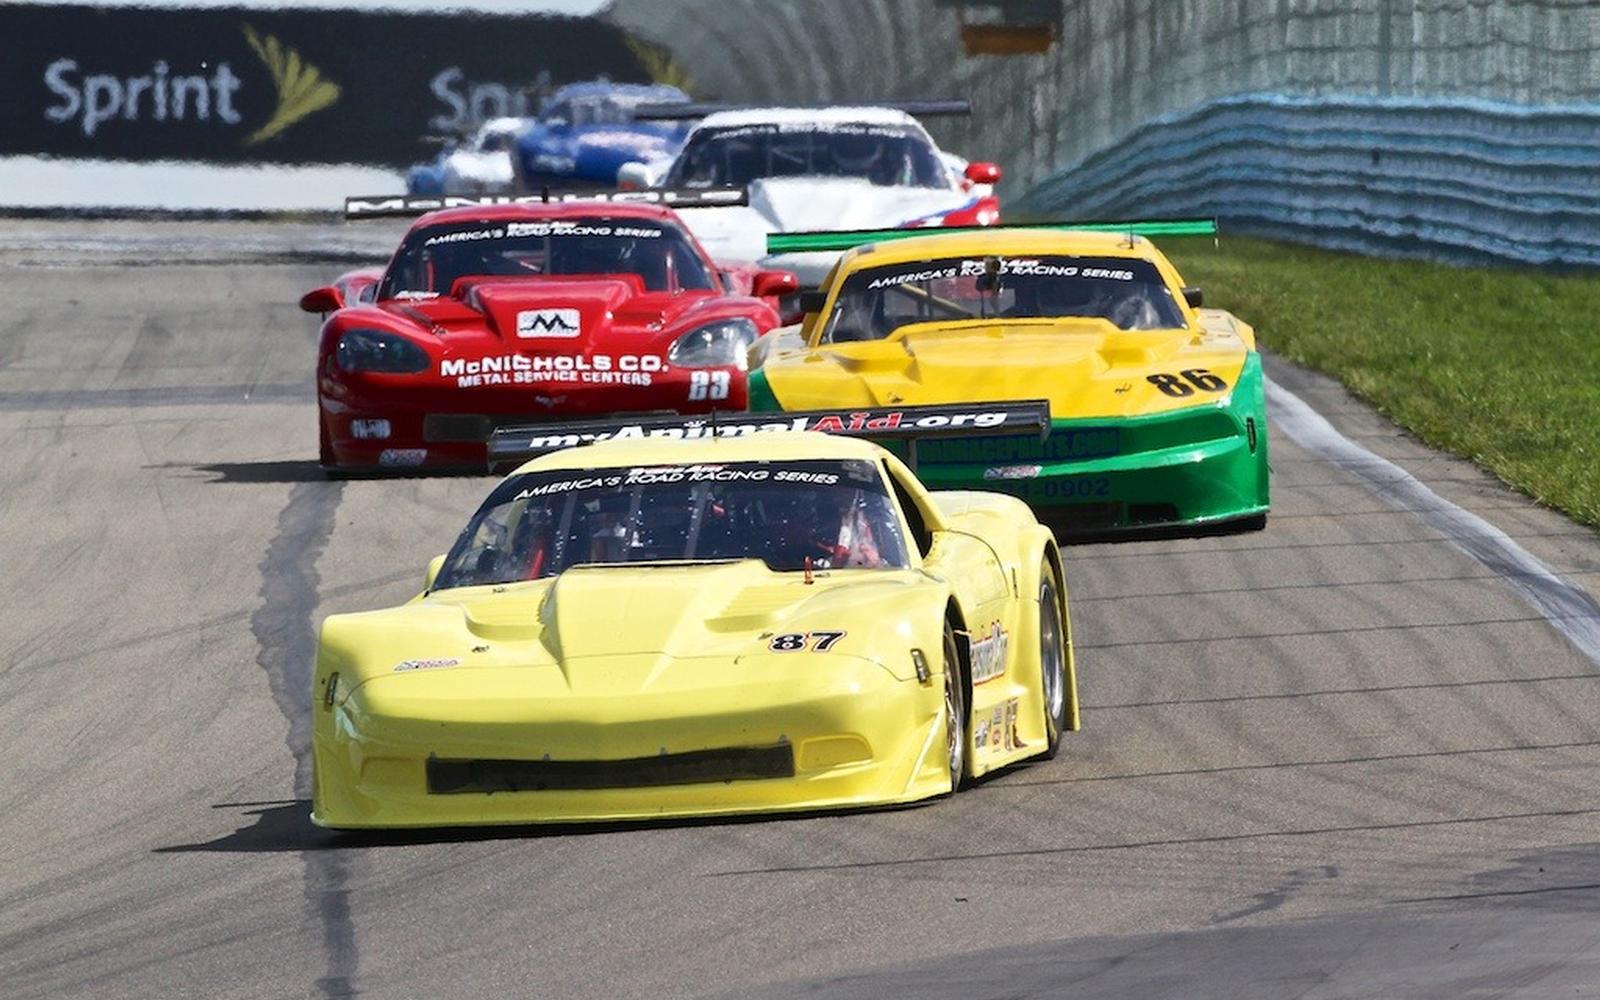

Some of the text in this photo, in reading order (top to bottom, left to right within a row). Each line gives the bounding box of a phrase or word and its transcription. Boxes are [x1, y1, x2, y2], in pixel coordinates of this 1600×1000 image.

[44, 57, 242, 137] Sprint
[424, 229, 504, 247] AMERICA'S
[552, 225, 611, 237] RACING
[613, 226, 662, 238] SERIES
[868, 268, 956, 290] AMERICA'S
[1011, 265, 1077, 277] RACING
[1081, 267, 1134, 281] SERIES
[440, 354, 669, 376] McNICHOLS CO.
[457, 370, 652, 388] METAL SERVICE CENTERS
[1146, 368, 1228, 398] 86
[513, 469, 840, 500] AMERICA'S ROAD RACING SERIES
[769, 630, 847, 652] 87
